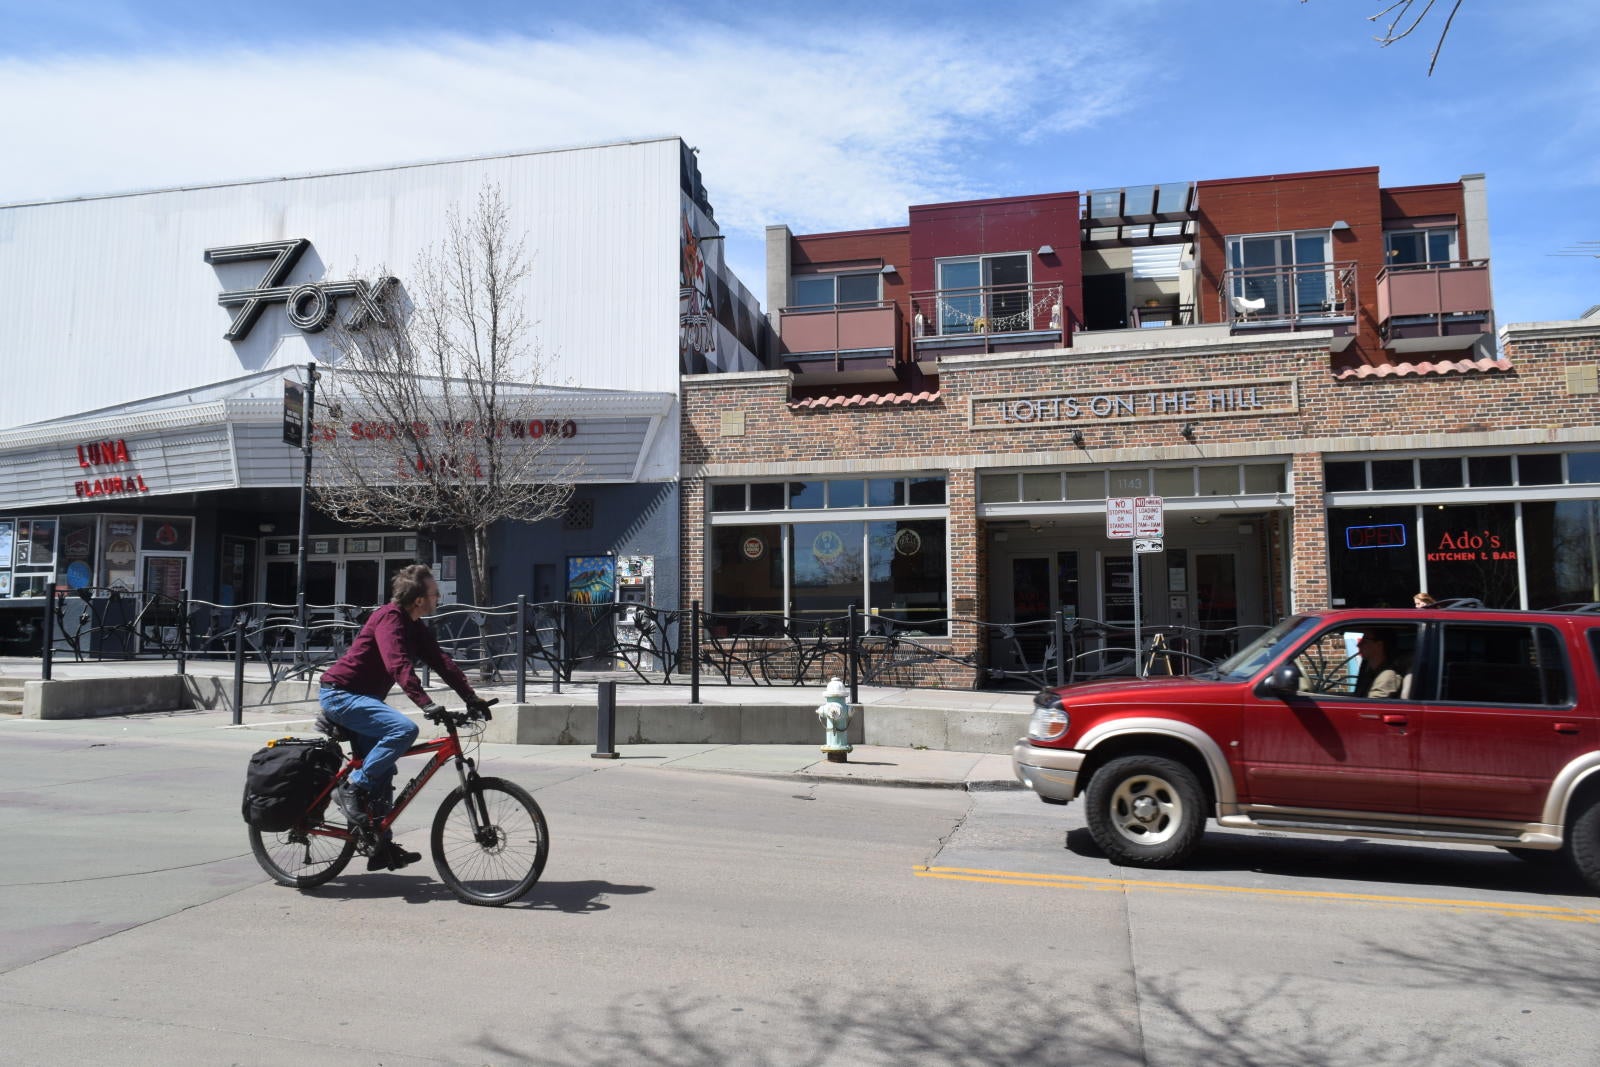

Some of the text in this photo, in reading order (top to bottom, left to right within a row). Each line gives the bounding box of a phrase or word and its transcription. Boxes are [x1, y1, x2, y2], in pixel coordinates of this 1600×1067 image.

[204, 238, 400, 342] FOX
[1001, 387, 1262, 421] LOFTS ON THE HILL
[76, 439, 129, 468] LUNA
[75, 474, 148, 497] FLAURAL
[1115, 501, 1126, 509] NO
[1136, 498, 1145, 506] NO
[1349, 526, 1403, 546] OPEN
[1438, 530, 1501, 550] Ado's
[1427, 552, 1476, 561] KITCHEN
[1492, 551, 1516, 560] BAR
